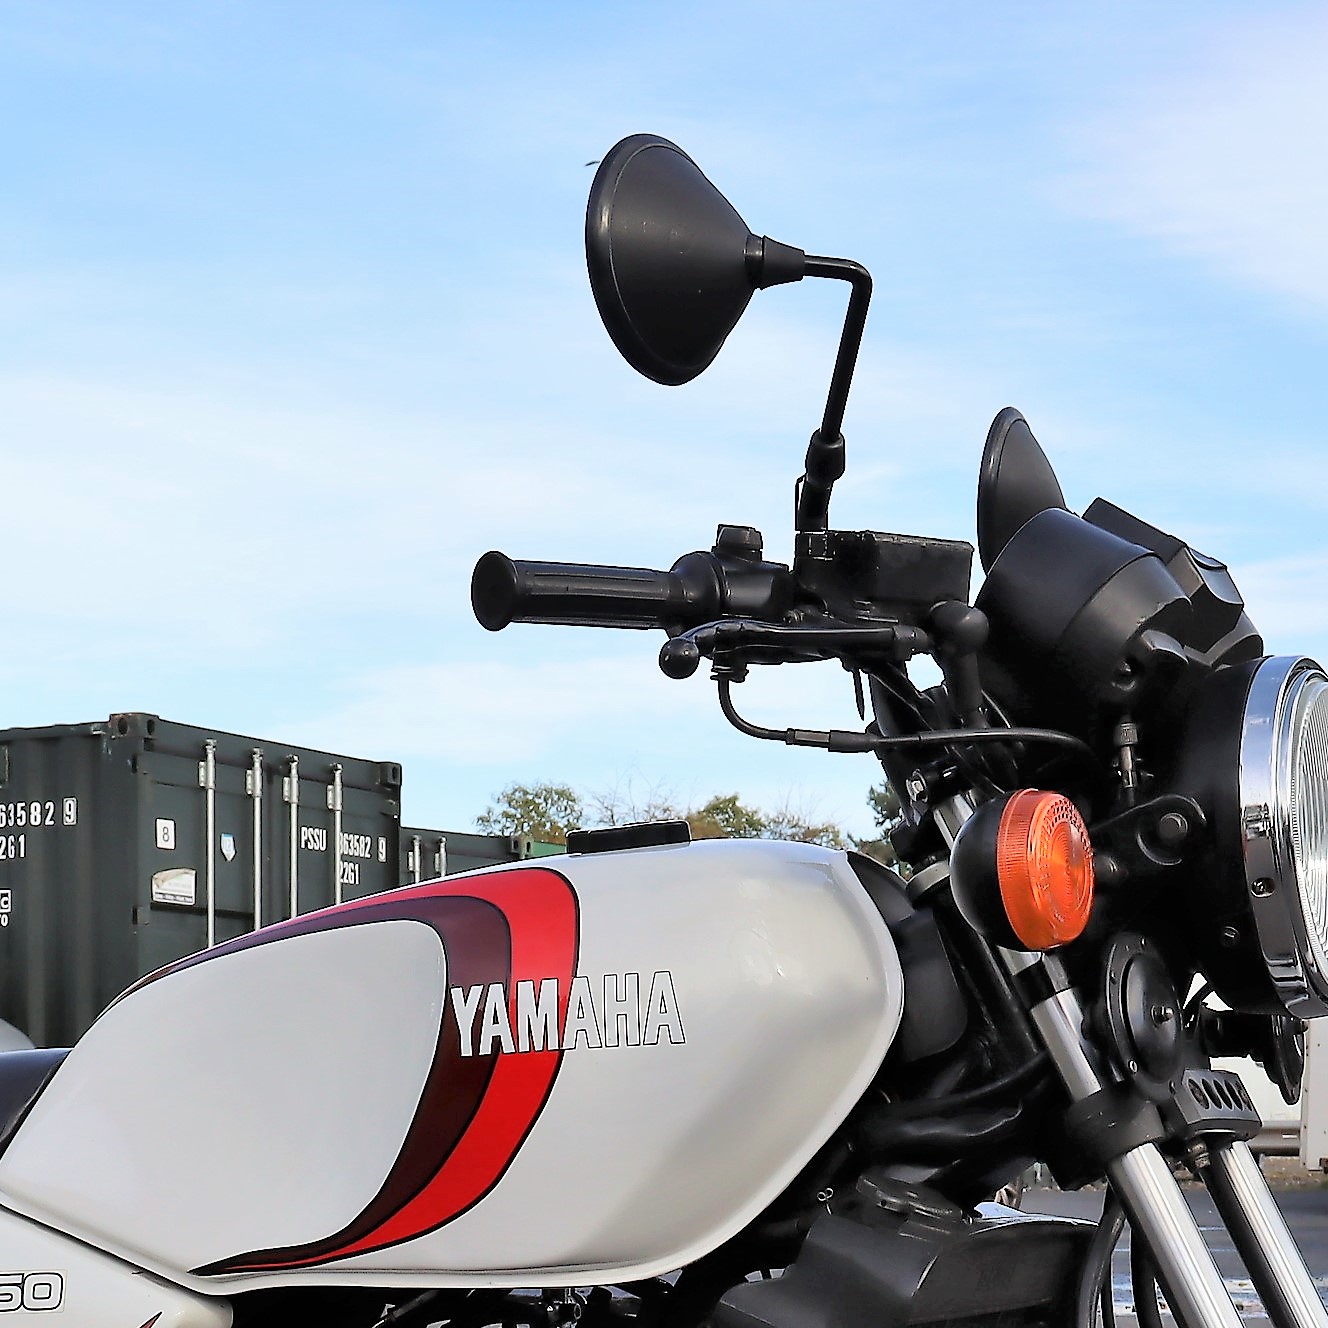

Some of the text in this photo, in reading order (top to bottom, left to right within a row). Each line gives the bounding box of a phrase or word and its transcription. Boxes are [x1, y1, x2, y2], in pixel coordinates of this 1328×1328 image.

[63, 798, 76, 825] 9
[162, 826, 170, 843] 8
[300, 826, 327, 851] PSSU
[378, 836, 387, 862] 9
[449, 970, 686, 1057] YAMAHA
